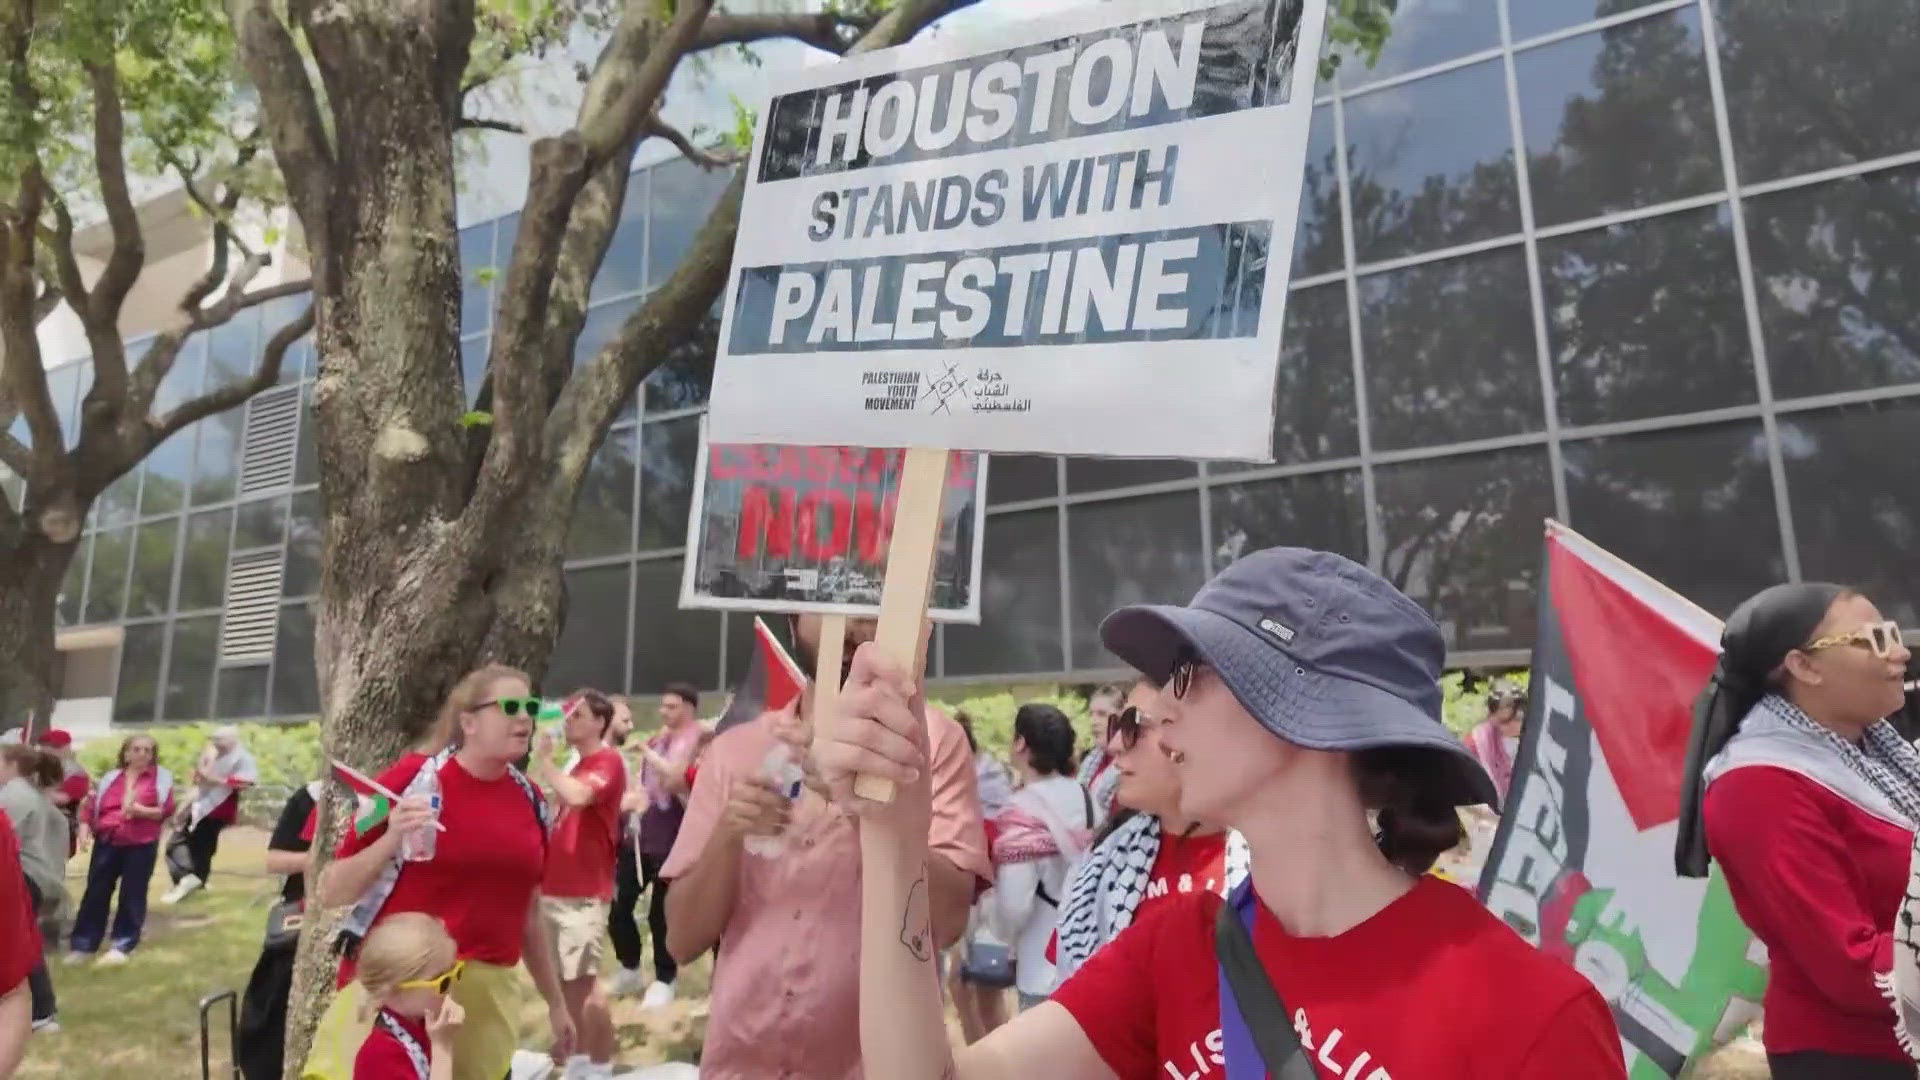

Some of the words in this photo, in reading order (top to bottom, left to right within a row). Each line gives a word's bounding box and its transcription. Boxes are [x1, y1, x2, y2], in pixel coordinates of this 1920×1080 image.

[815, 20, 1203, 165] HOUSTON
[808, 166, 1006, 242] STANDS
[1022, 145, 1178, 222] WITH
[768, 237, 1199, 345] PALESTINE
[862, 371, 920, 385] PALESTINIAN
[977, 368, 1002, 384] حركة
[888, 385, 918, 398] YOUTH
[975, 383, 1009, 400] الشباب
[865, 397, 915, 410] MOVEMENT
[1317, 1028, 1394, 1080] LI
